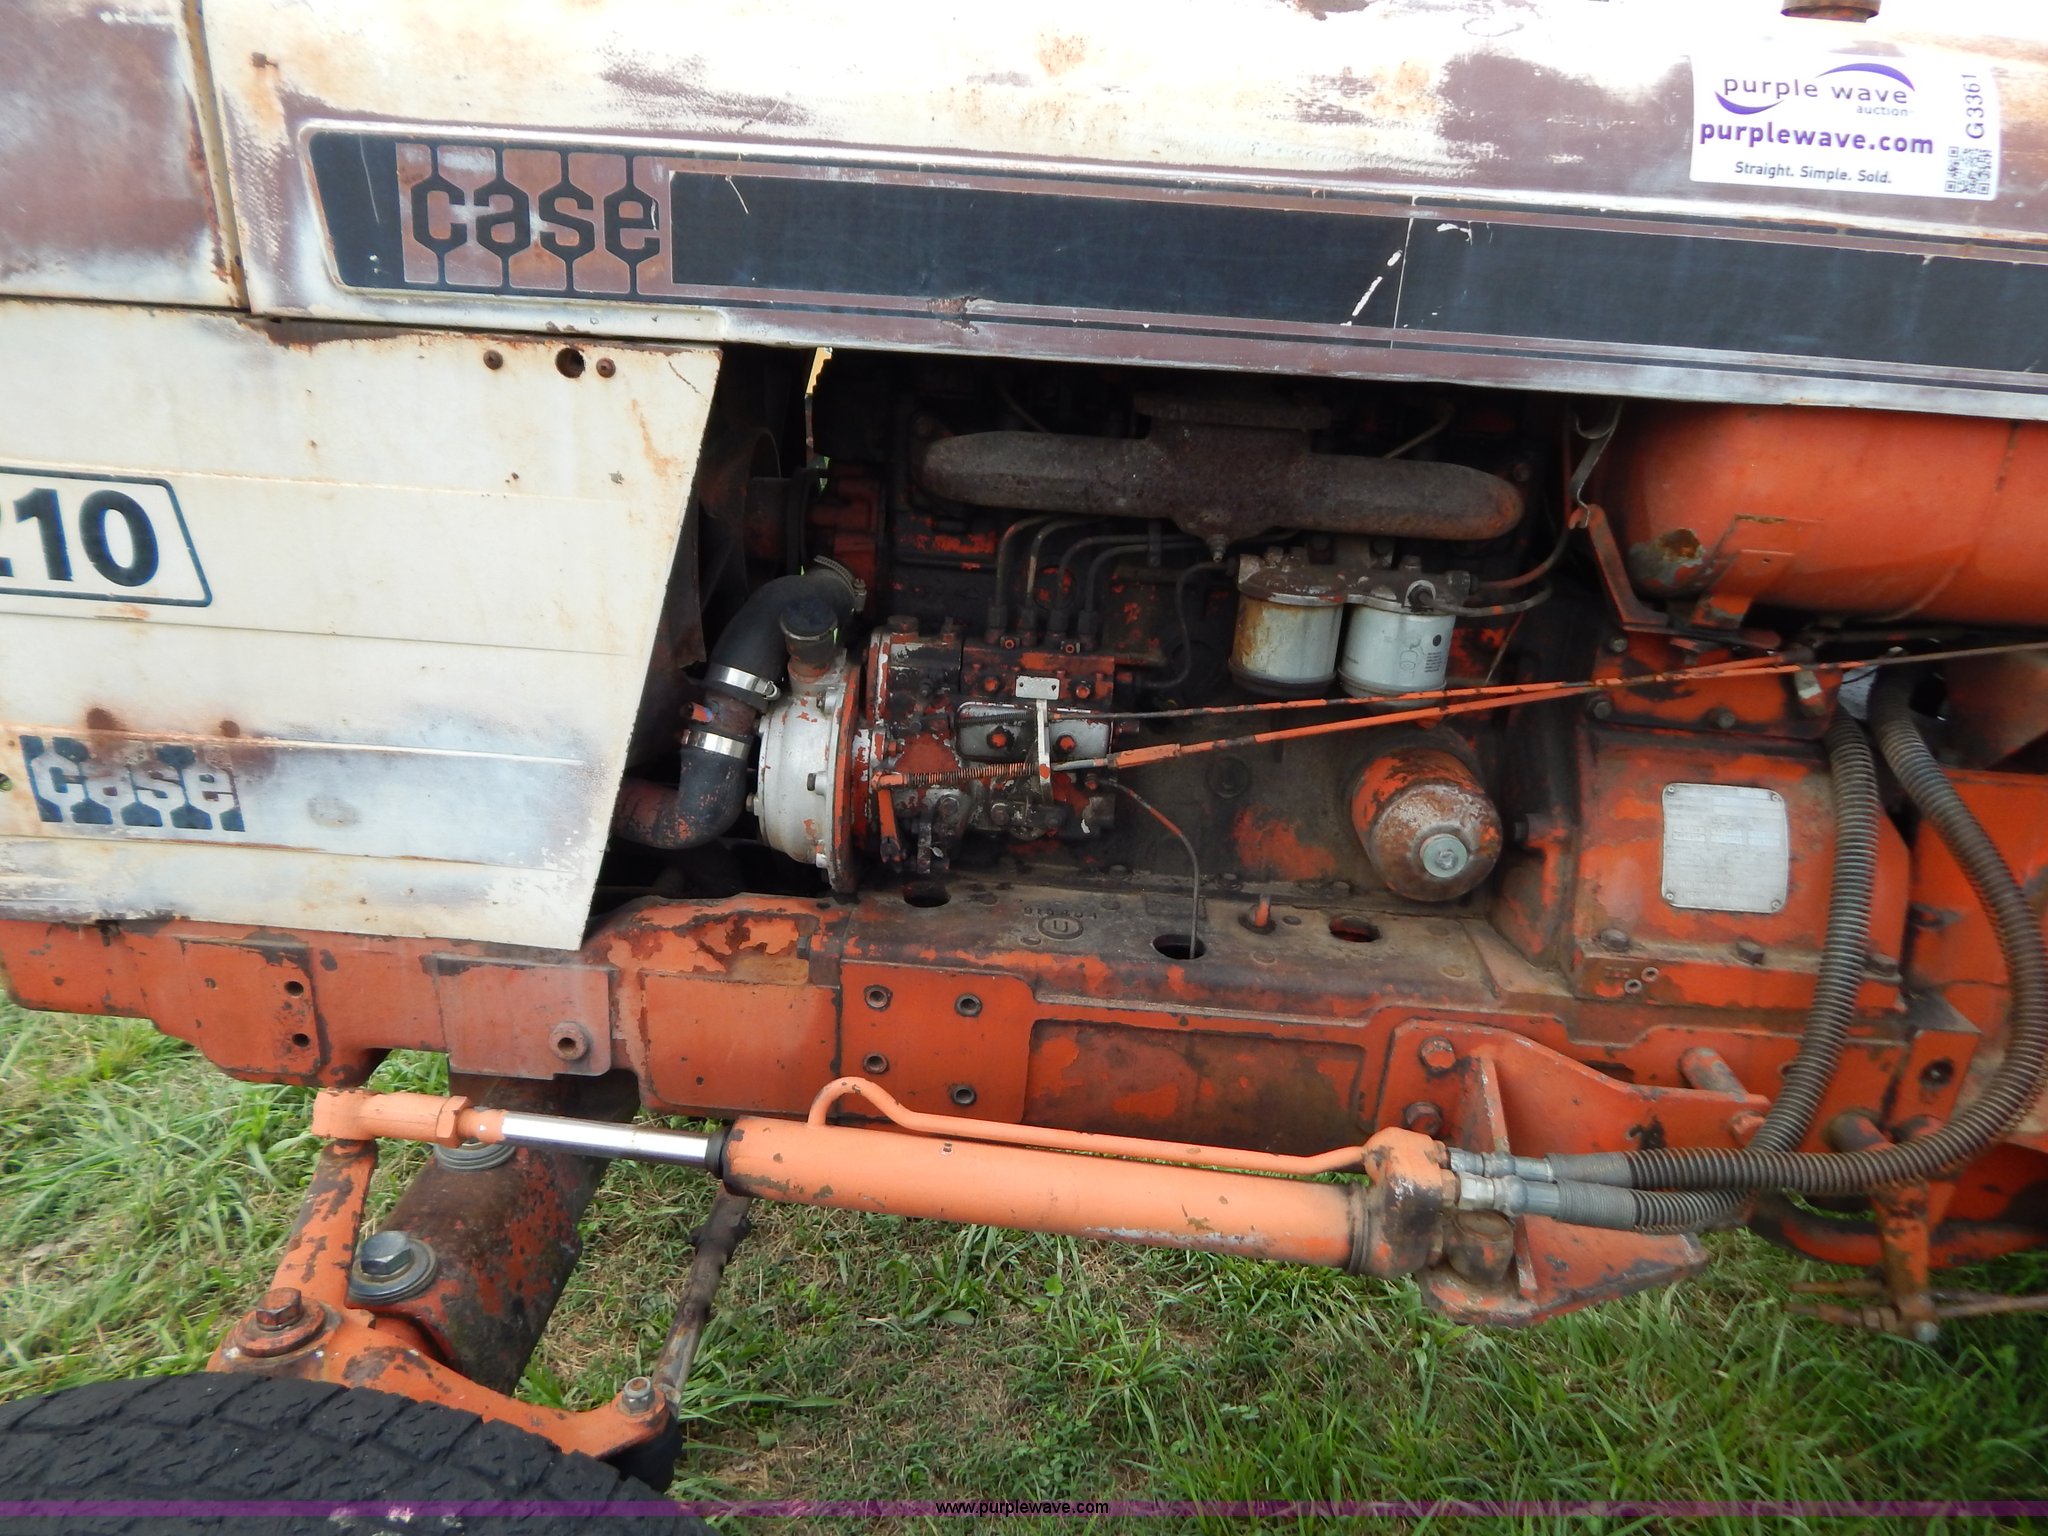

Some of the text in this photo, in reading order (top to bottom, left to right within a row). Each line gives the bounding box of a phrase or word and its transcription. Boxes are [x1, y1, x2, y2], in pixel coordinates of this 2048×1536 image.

[1723, 77, 1909, 104] purple wave
[1856, 104, 1909, 117] auction
[1961, 73, 1986, 139] G3361
[1700, 121, 1934, 155] purplewave.com
[1735, 161, 1892, 184] Straight. Simple. Sold.
[0, 487, 159, 588] 10
